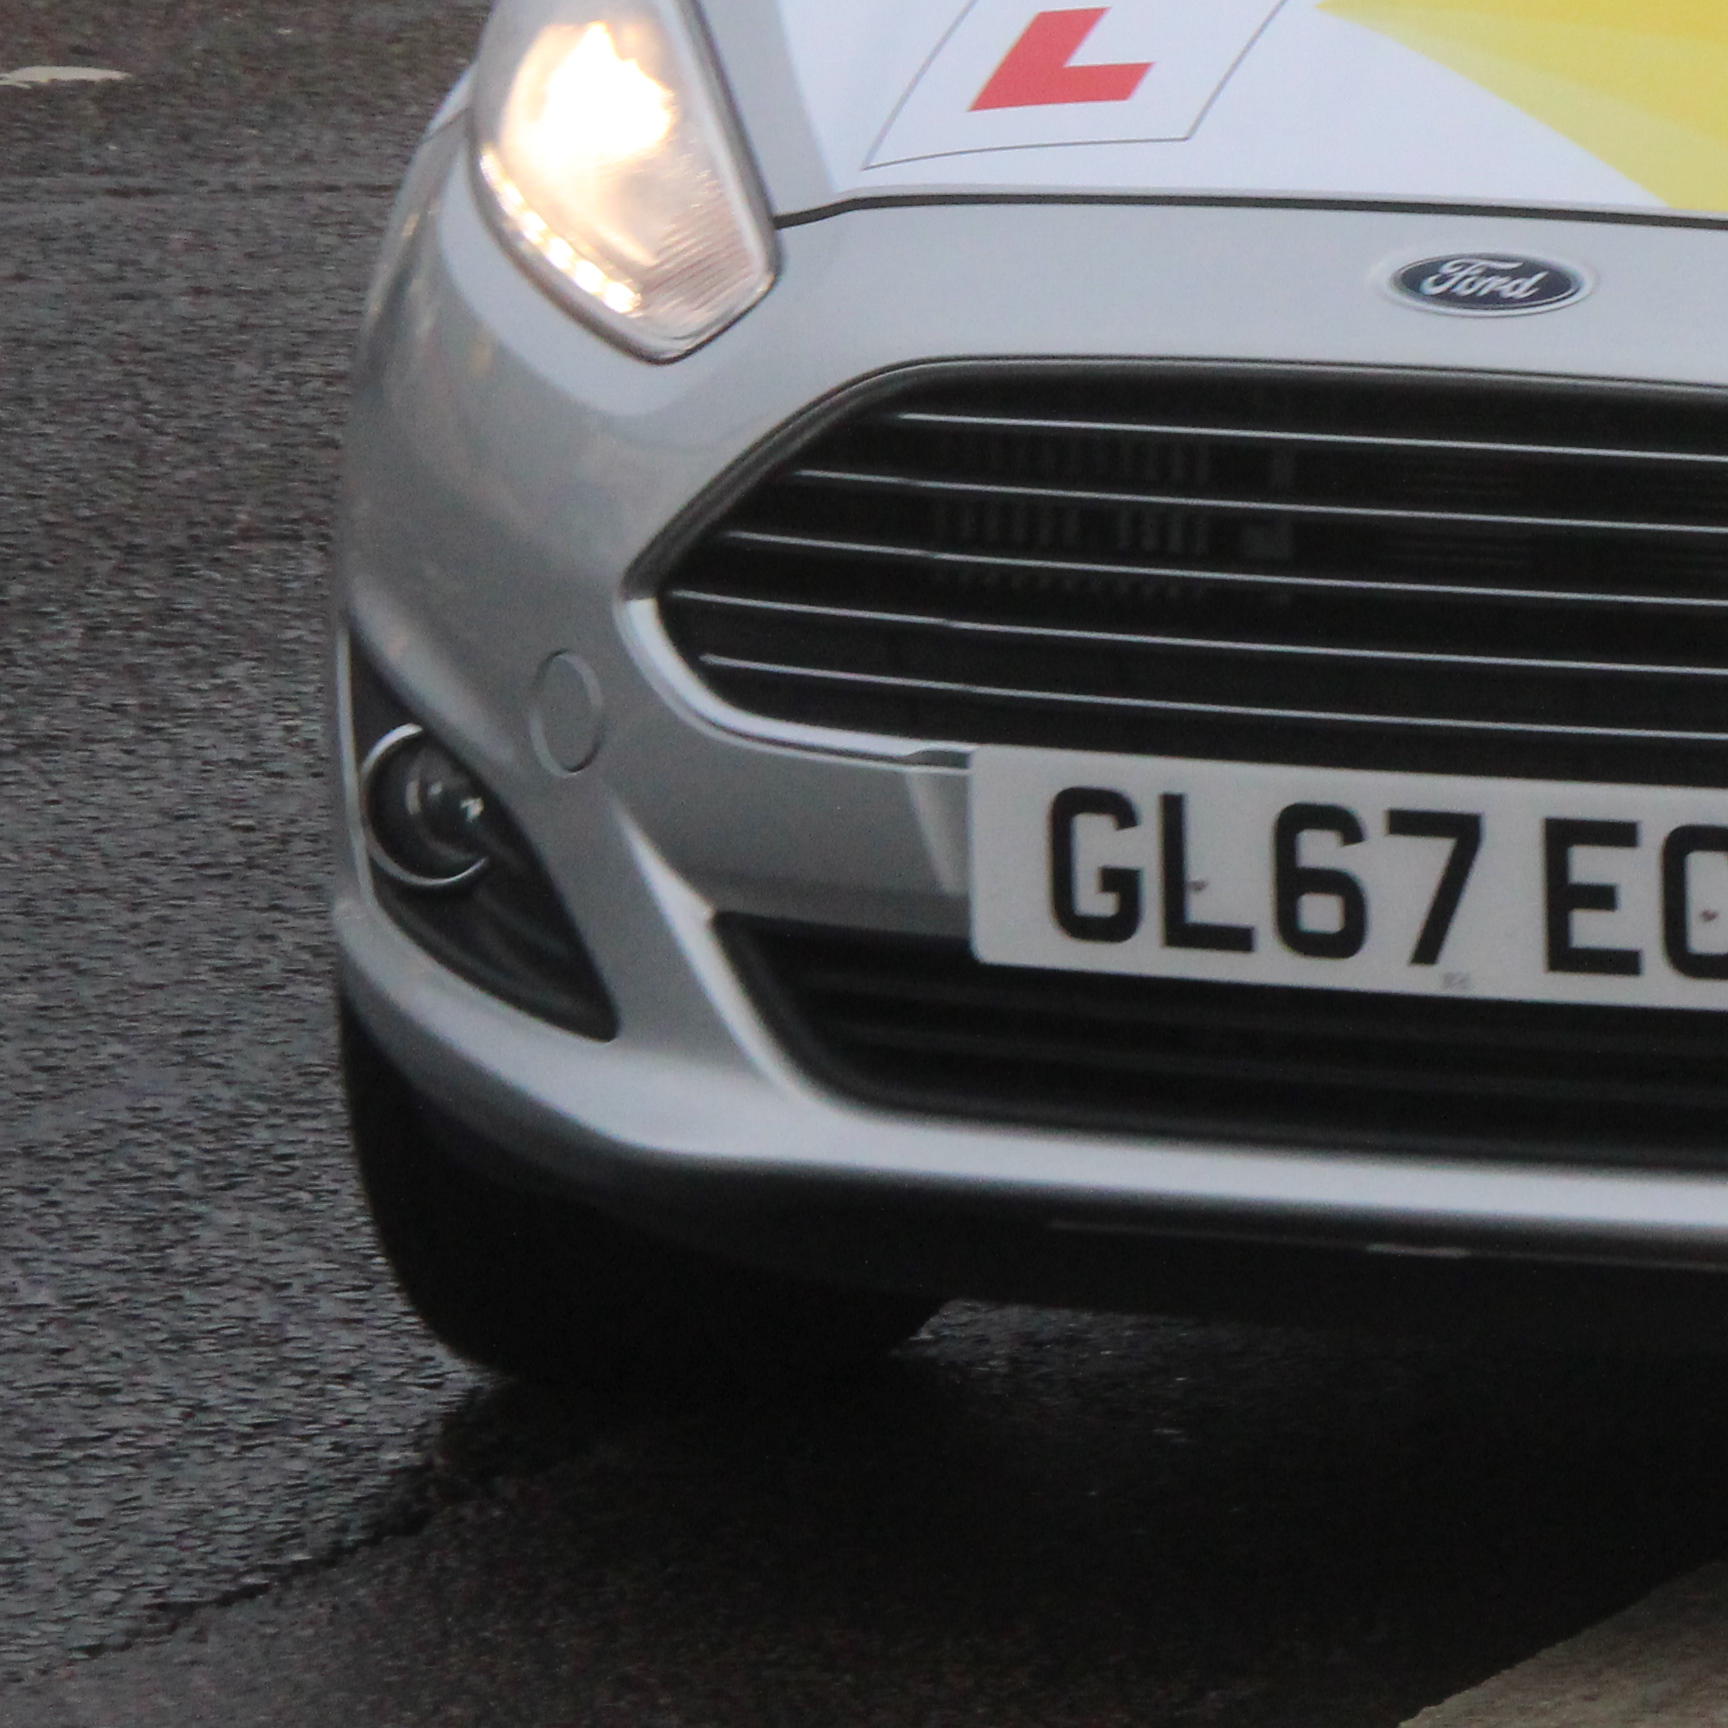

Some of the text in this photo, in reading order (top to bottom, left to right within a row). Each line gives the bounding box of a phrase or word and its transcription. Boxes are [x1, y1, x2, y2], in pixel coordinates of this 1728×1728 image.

[968, 6, 1176, 113] L
[1420, 258, 1550, 300] Ford
[1049, 786, 1484, 966] GL67
